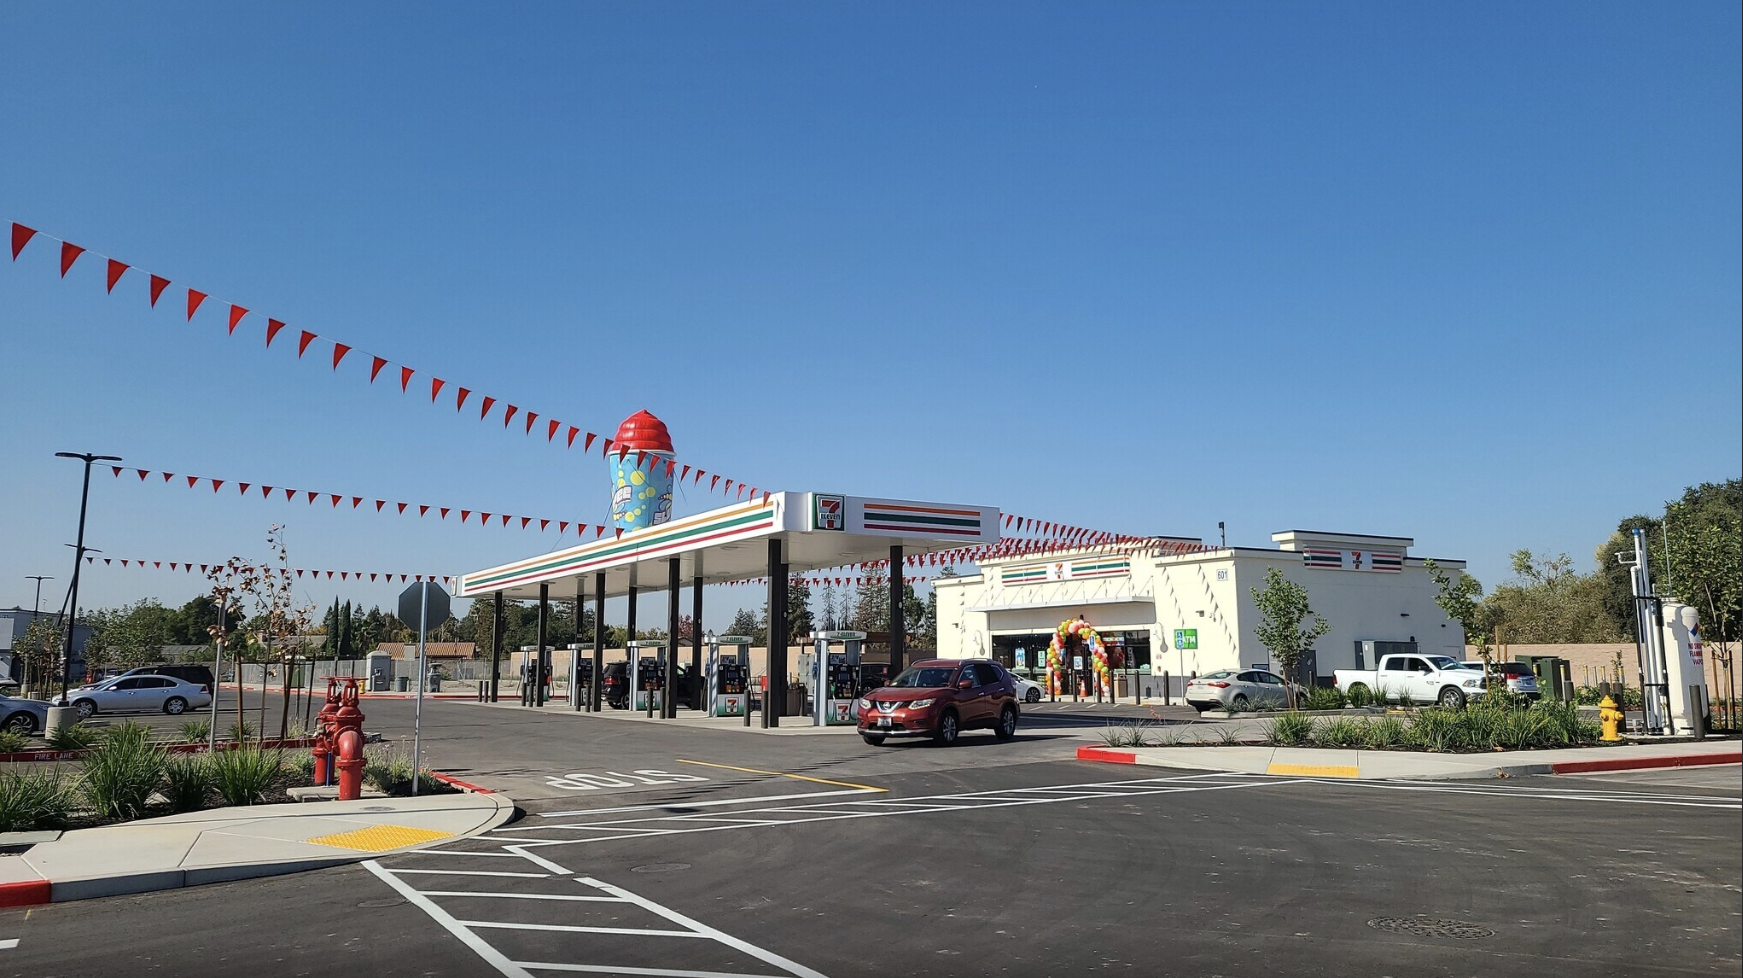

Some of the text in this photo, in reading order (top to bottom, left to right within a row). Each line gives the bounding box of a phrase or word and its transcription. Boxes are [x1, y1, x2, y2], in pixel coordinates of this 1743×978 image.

[820, 499, 841, 529] 7
[1351, 551, 1361, 569] 7
[1217, 570, 1228, 579] 601
[727, 699, 737, 713] 7
[837, 705, 849, 720] 7
[543, 769, 711, 791] STOP
